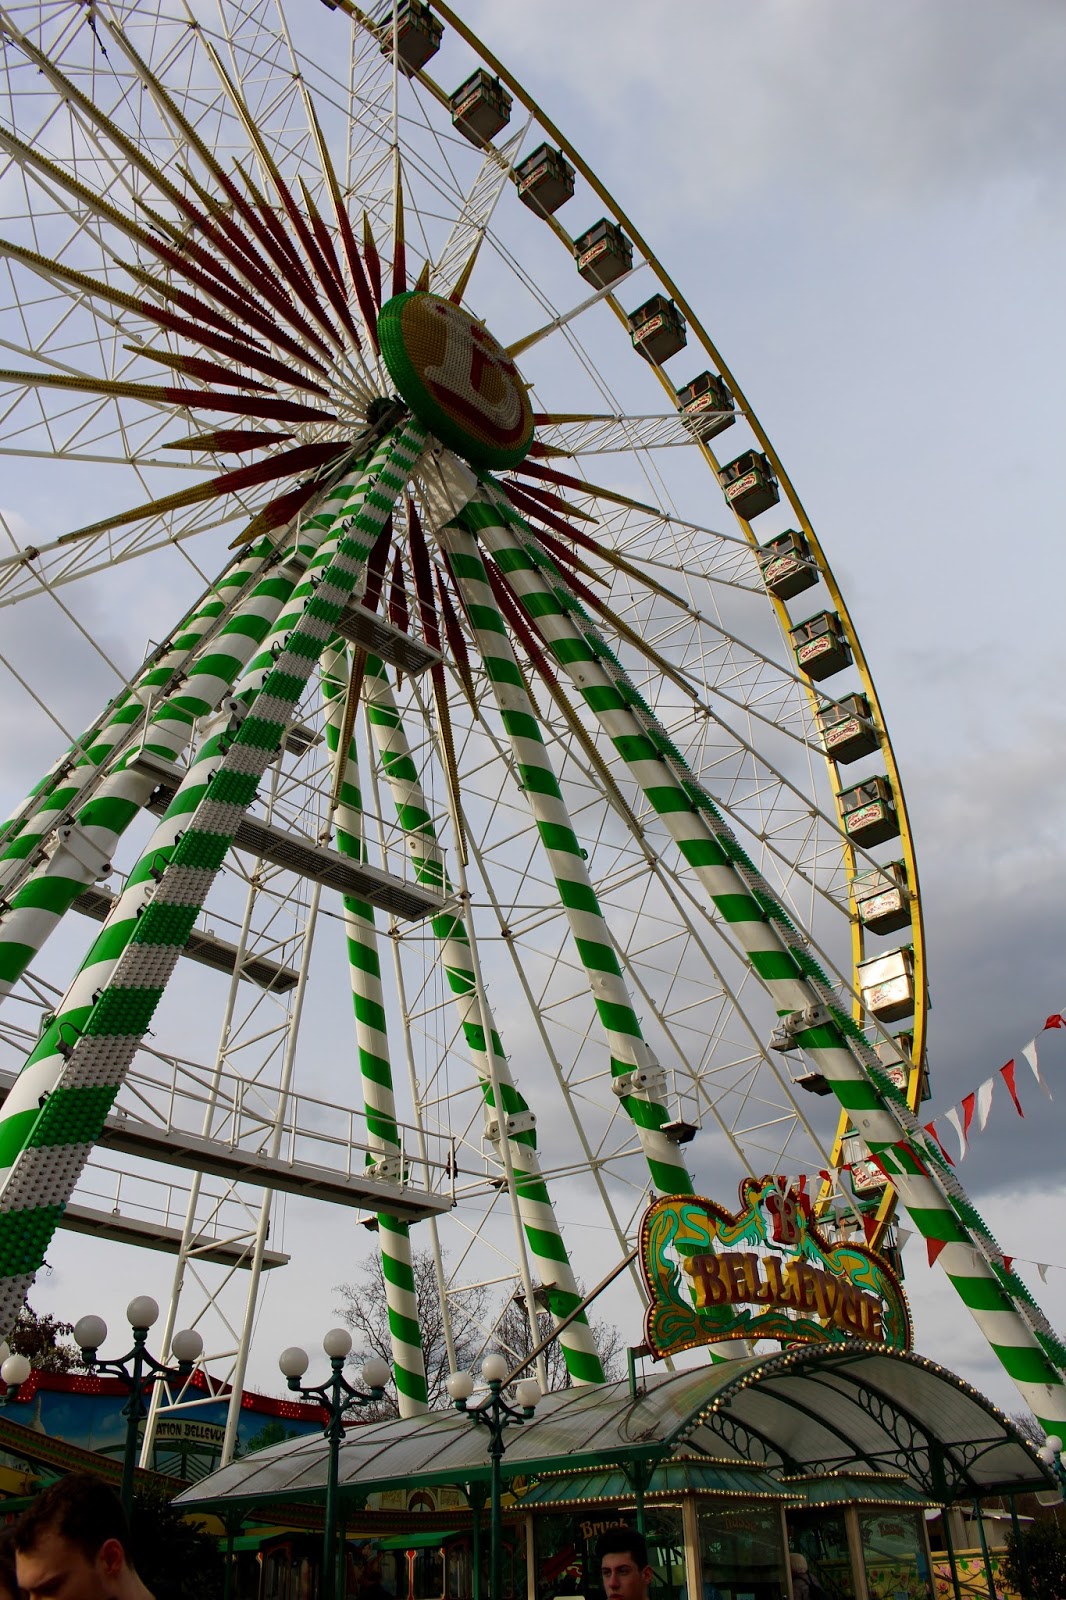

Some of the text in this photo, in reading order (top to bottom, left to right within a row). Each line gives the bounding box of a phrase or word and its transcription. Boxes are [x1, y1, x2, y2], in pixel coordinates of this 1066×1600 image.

[766, 1194, 802, 1245] B
[684, 1252, 887, 1343] BELLEVUE
[155, 1422, 182, 1436] ATION
